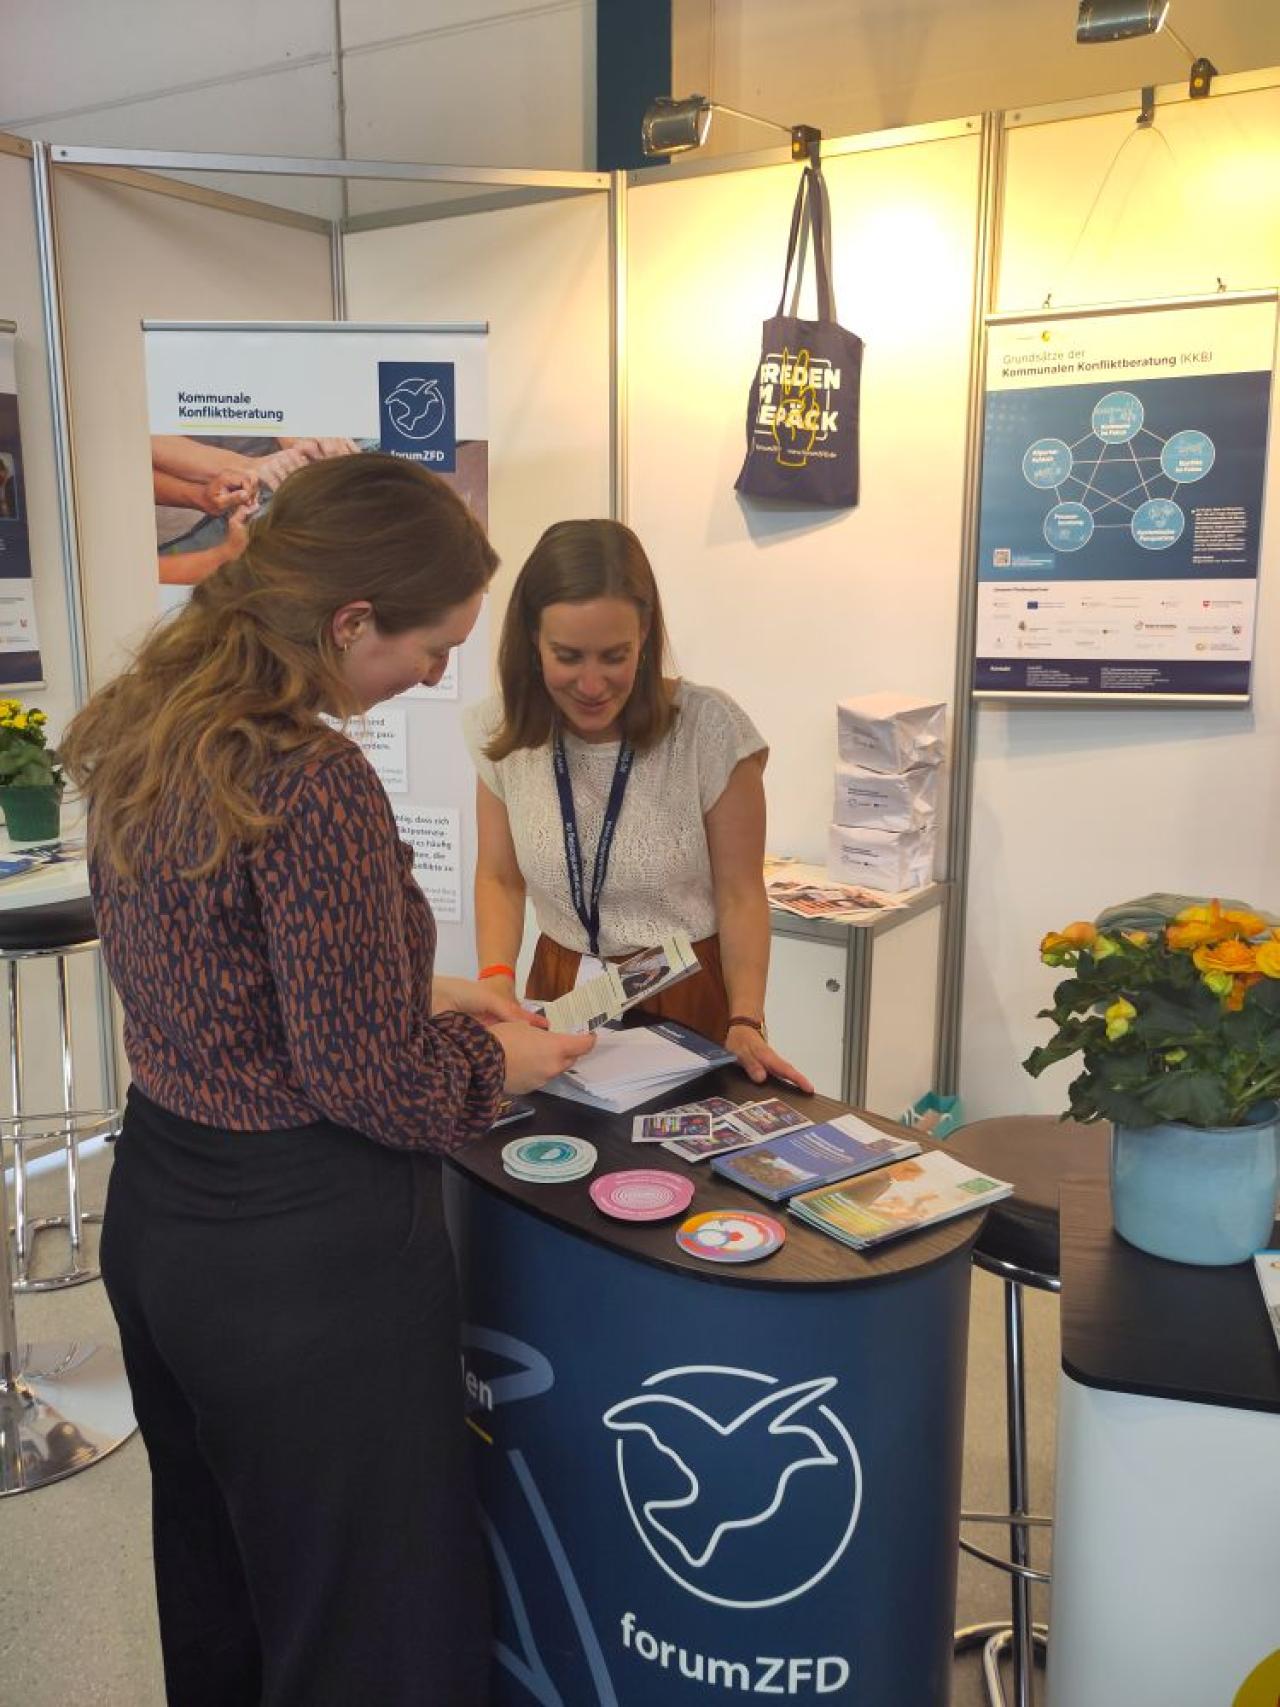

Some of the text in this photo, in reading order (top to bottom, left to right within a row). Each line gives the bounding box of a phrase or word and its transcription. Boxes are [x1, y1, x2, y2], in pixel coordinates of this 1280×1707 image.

[1002, 351, 1213, 378] Kommunalen Konfliktberatung (KKB)
[1003, 349, 1085, 365] Grundsätze der
[178, 391, 252, 404] Kommunale
[178, 405, 284, 422] Konfliktberatung
[758, 402, 839, 432] EPÄCK
[620, 1611, 850, 1694] forumZFD
